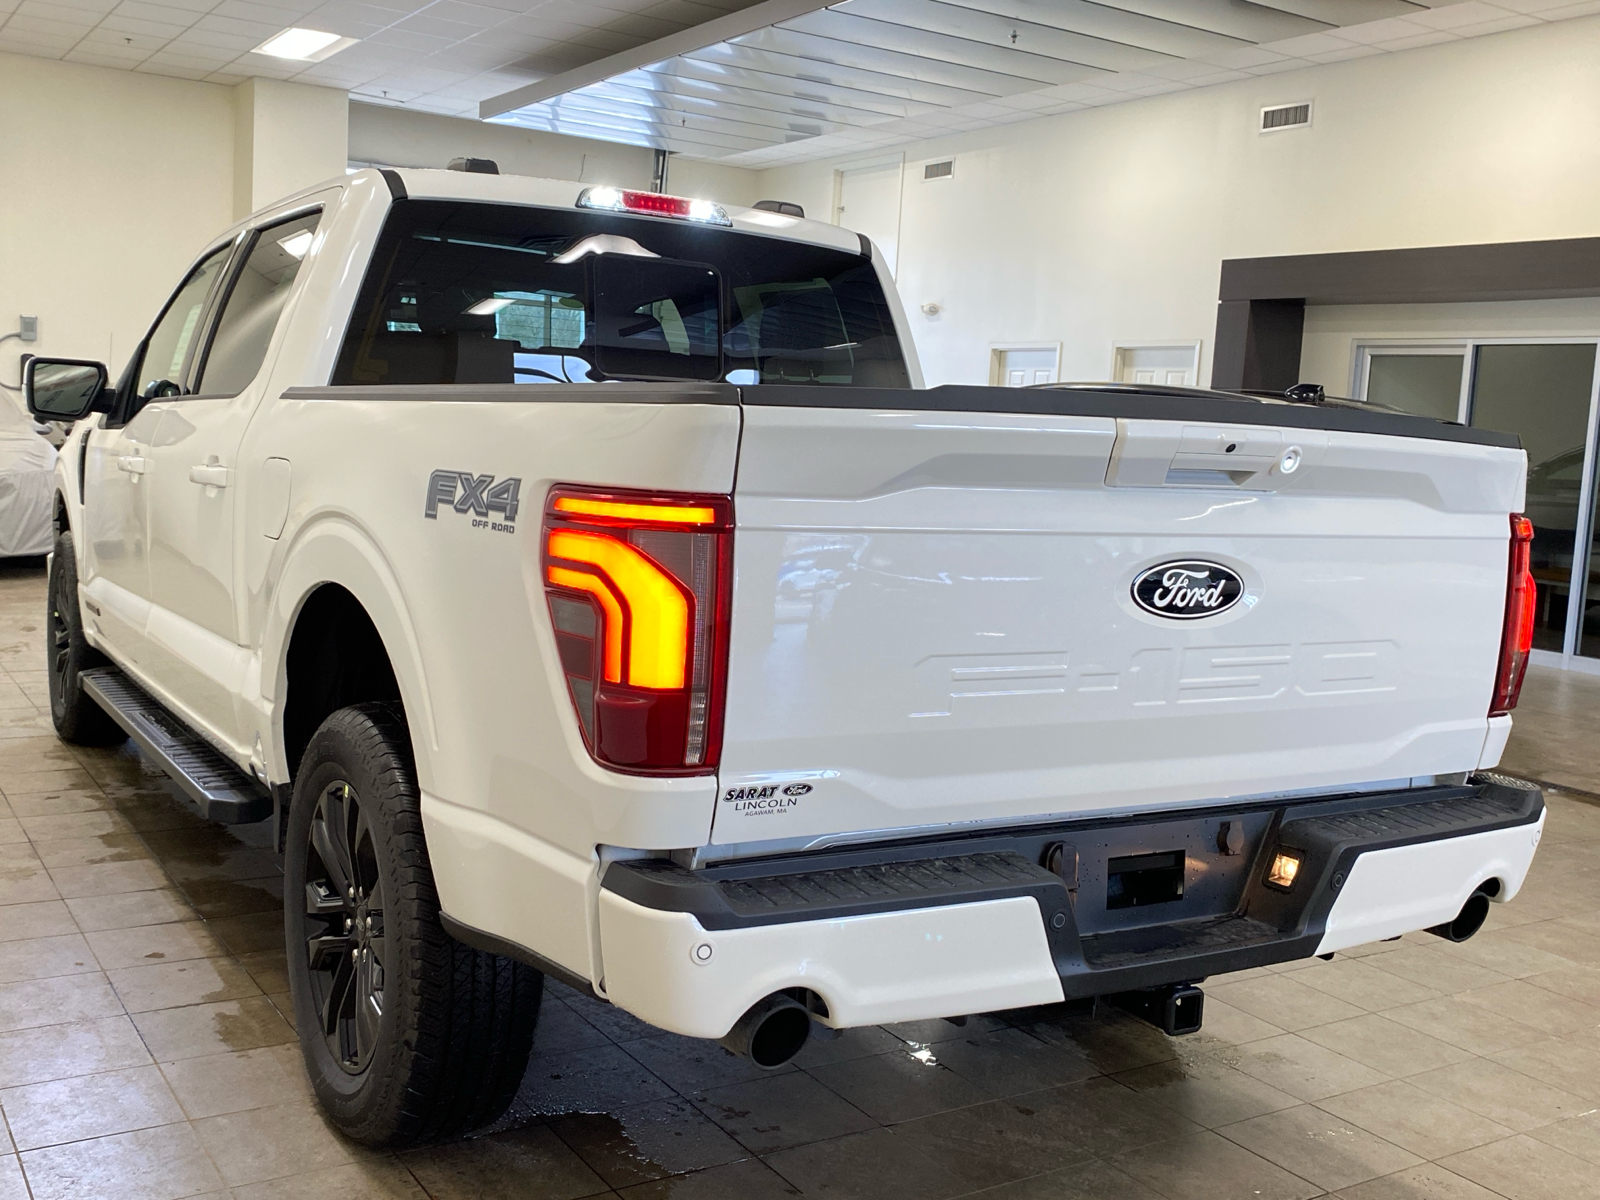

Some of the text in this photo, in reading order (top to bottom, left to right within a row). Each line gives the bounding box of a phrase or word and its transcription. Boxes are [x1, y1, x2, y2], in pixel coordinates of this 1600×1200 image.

[425, 469, 522, 522] FX4
[472, 519, 515, 534] OFF ROAD
[1153, 569, 1226, 608] Ford
[906, 638, 1401, 717] F-150
[724, 785, 809, 802] SARAT Ford
[735, 798, 797, 811] LINCOLN
[745, 809, 775, 817] AGAWAM,
